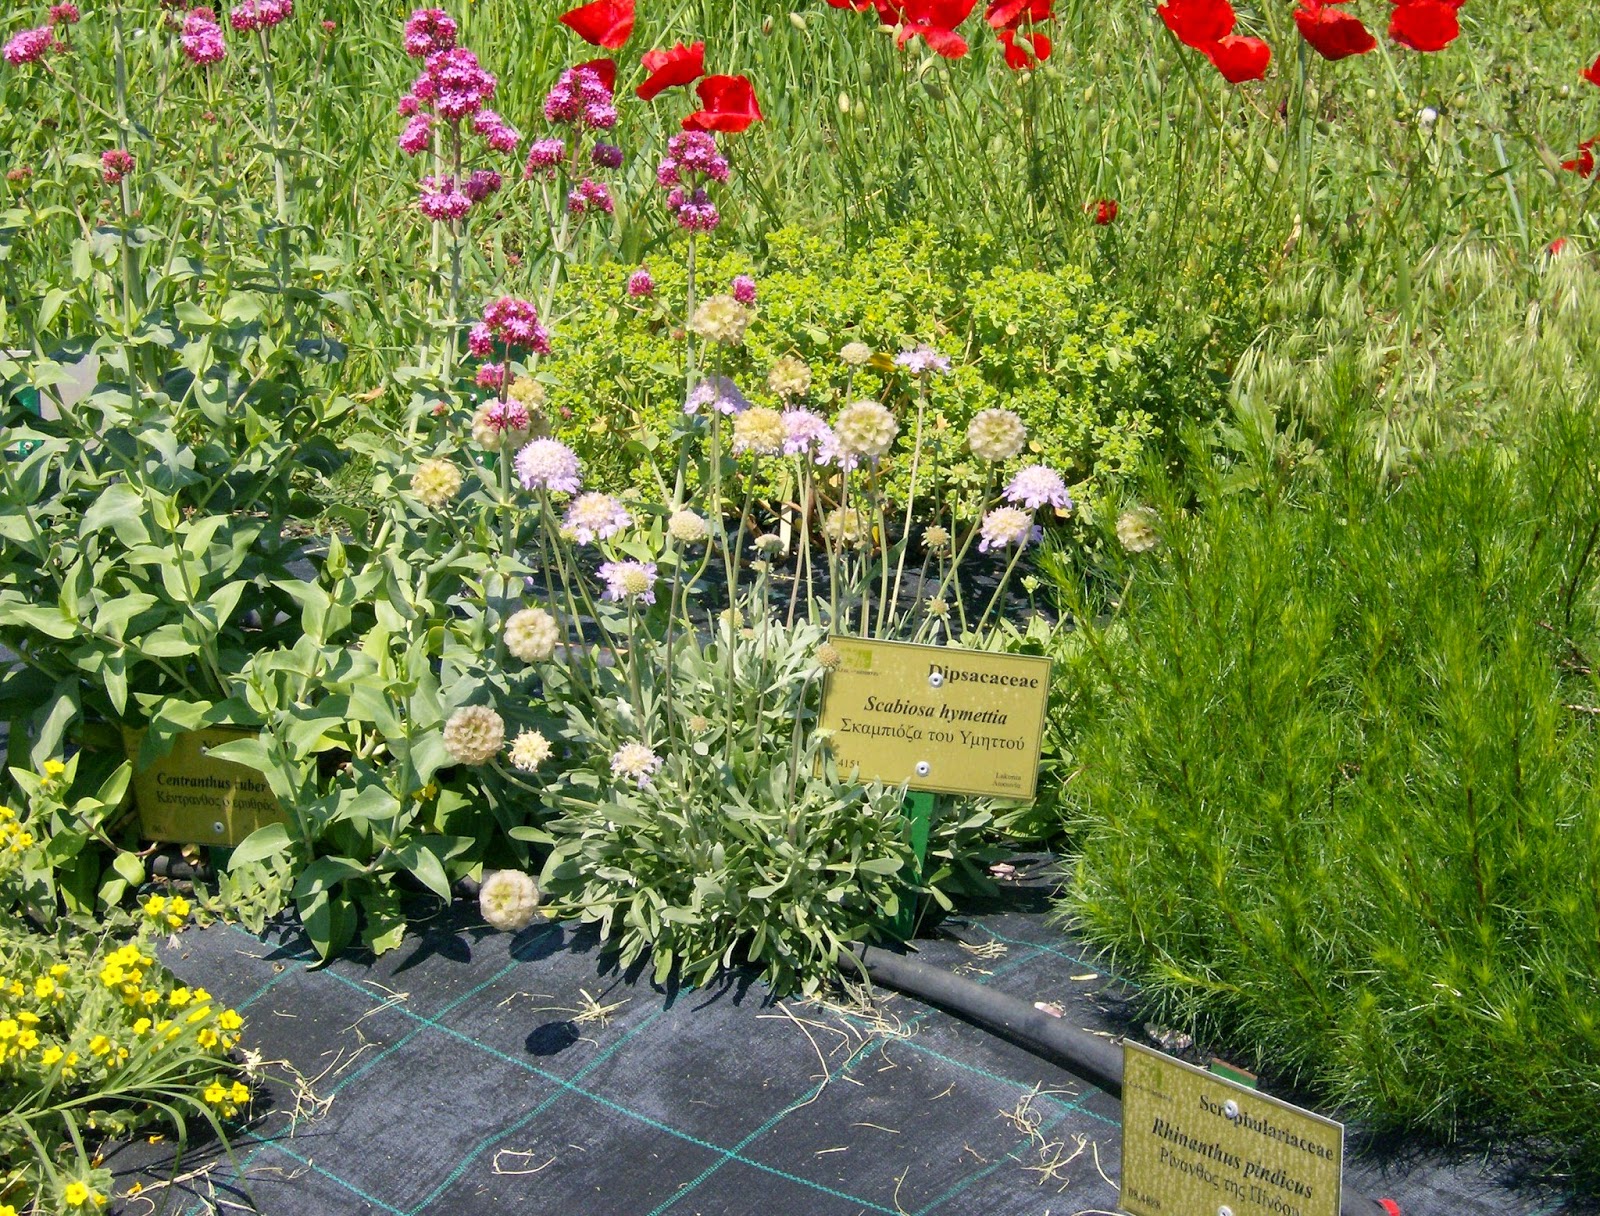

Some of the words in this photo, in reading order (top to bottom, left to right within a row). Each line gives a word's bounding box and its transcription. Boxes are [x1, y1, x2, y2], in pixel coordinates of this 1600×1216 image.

[864, 695, 935, 718] Scabiosa
[939, 702, 1008, 725] hymettia
[840, 718, 922, 743] Σκαμπιόζα
[928, 731, 954, 743] του
[960, 730, 1025, 751] Υμηττού
[156, 772, 231, 789] Centranthus
[1152, 1117, 1240, 1170] Rhinanthus
[1243, 1159, 1314, 1199] pindicus
[1224, 1179, 1245, 1202] της
